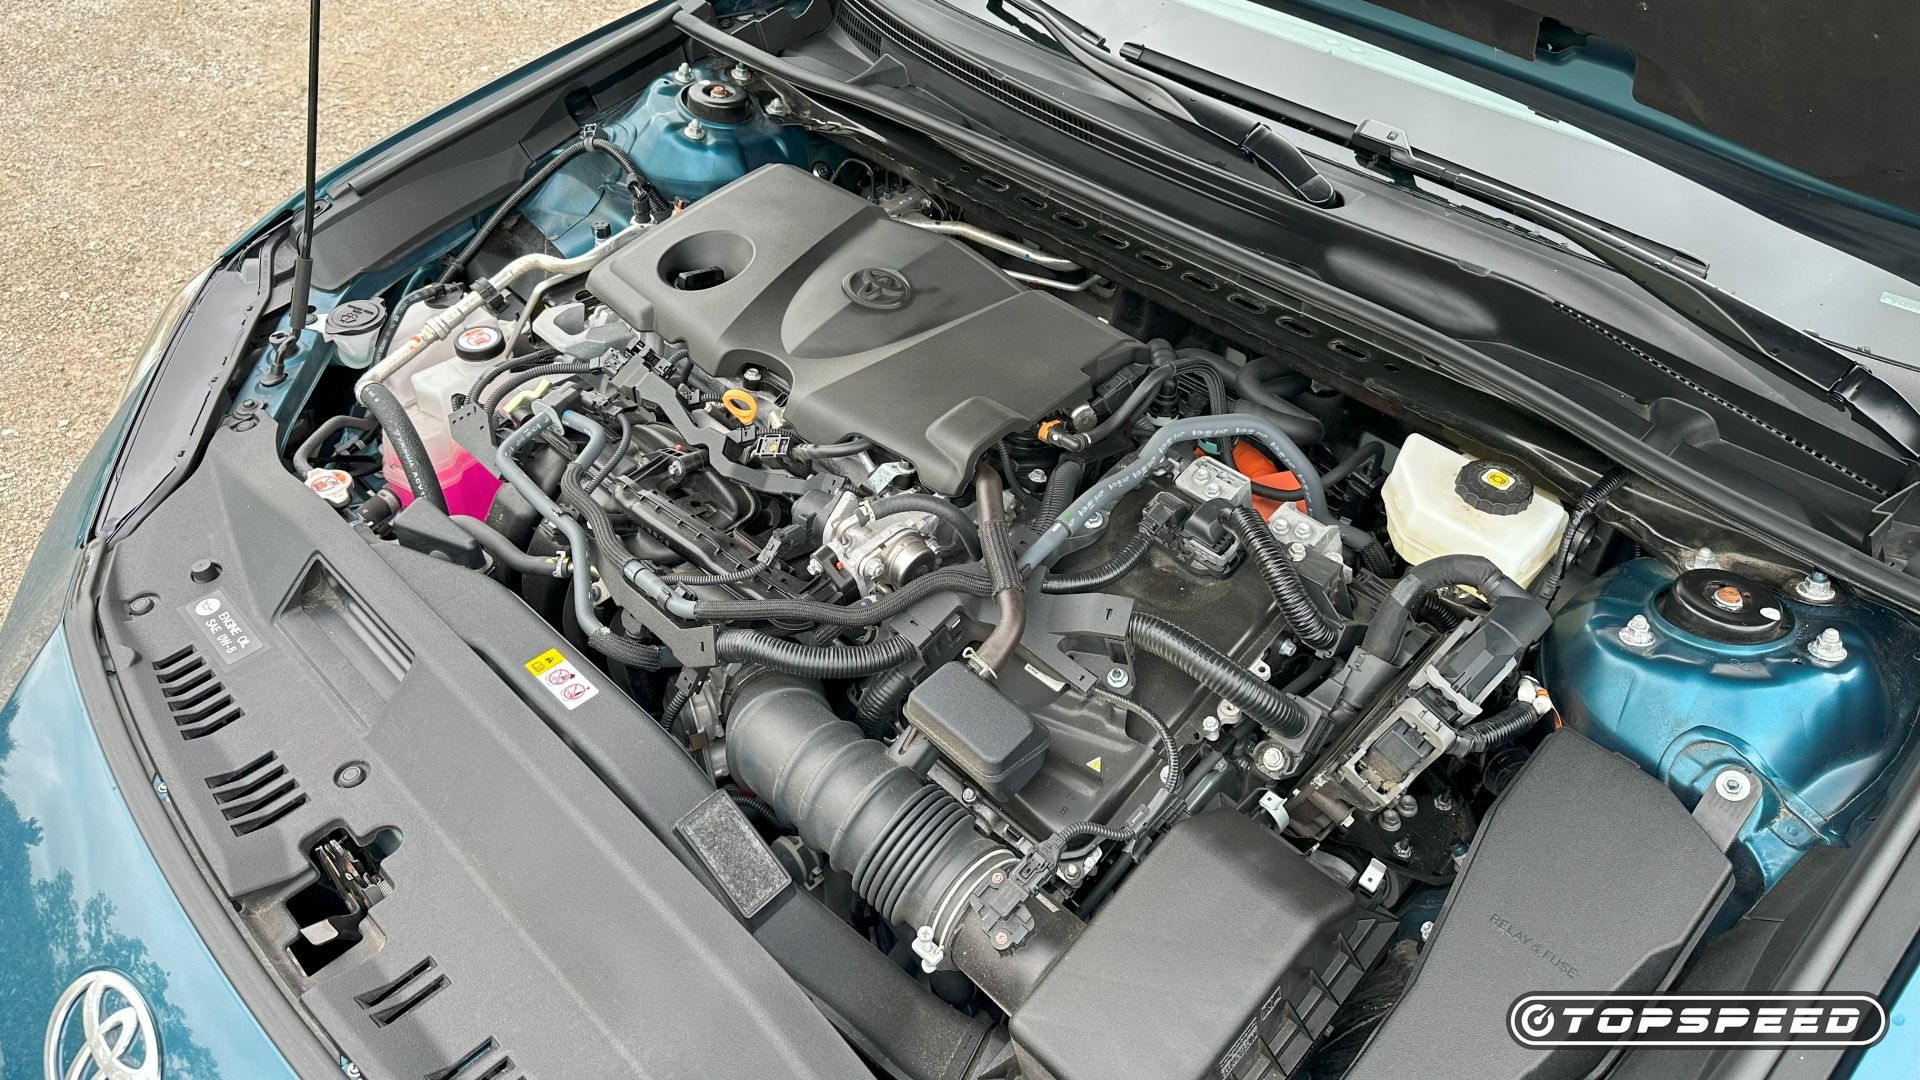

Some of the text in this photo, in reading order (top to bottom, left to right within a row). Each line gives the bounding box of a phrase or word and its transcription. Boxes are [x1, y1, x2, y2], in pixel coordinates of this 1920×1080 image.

[205, 618, 237, 654] SAE 0W-8
[218, 612, 250, 649] ENGINE OIL
[1489, 913, 1532, 944] RELAY
[1542, 949, 1579, 979] FUSE
